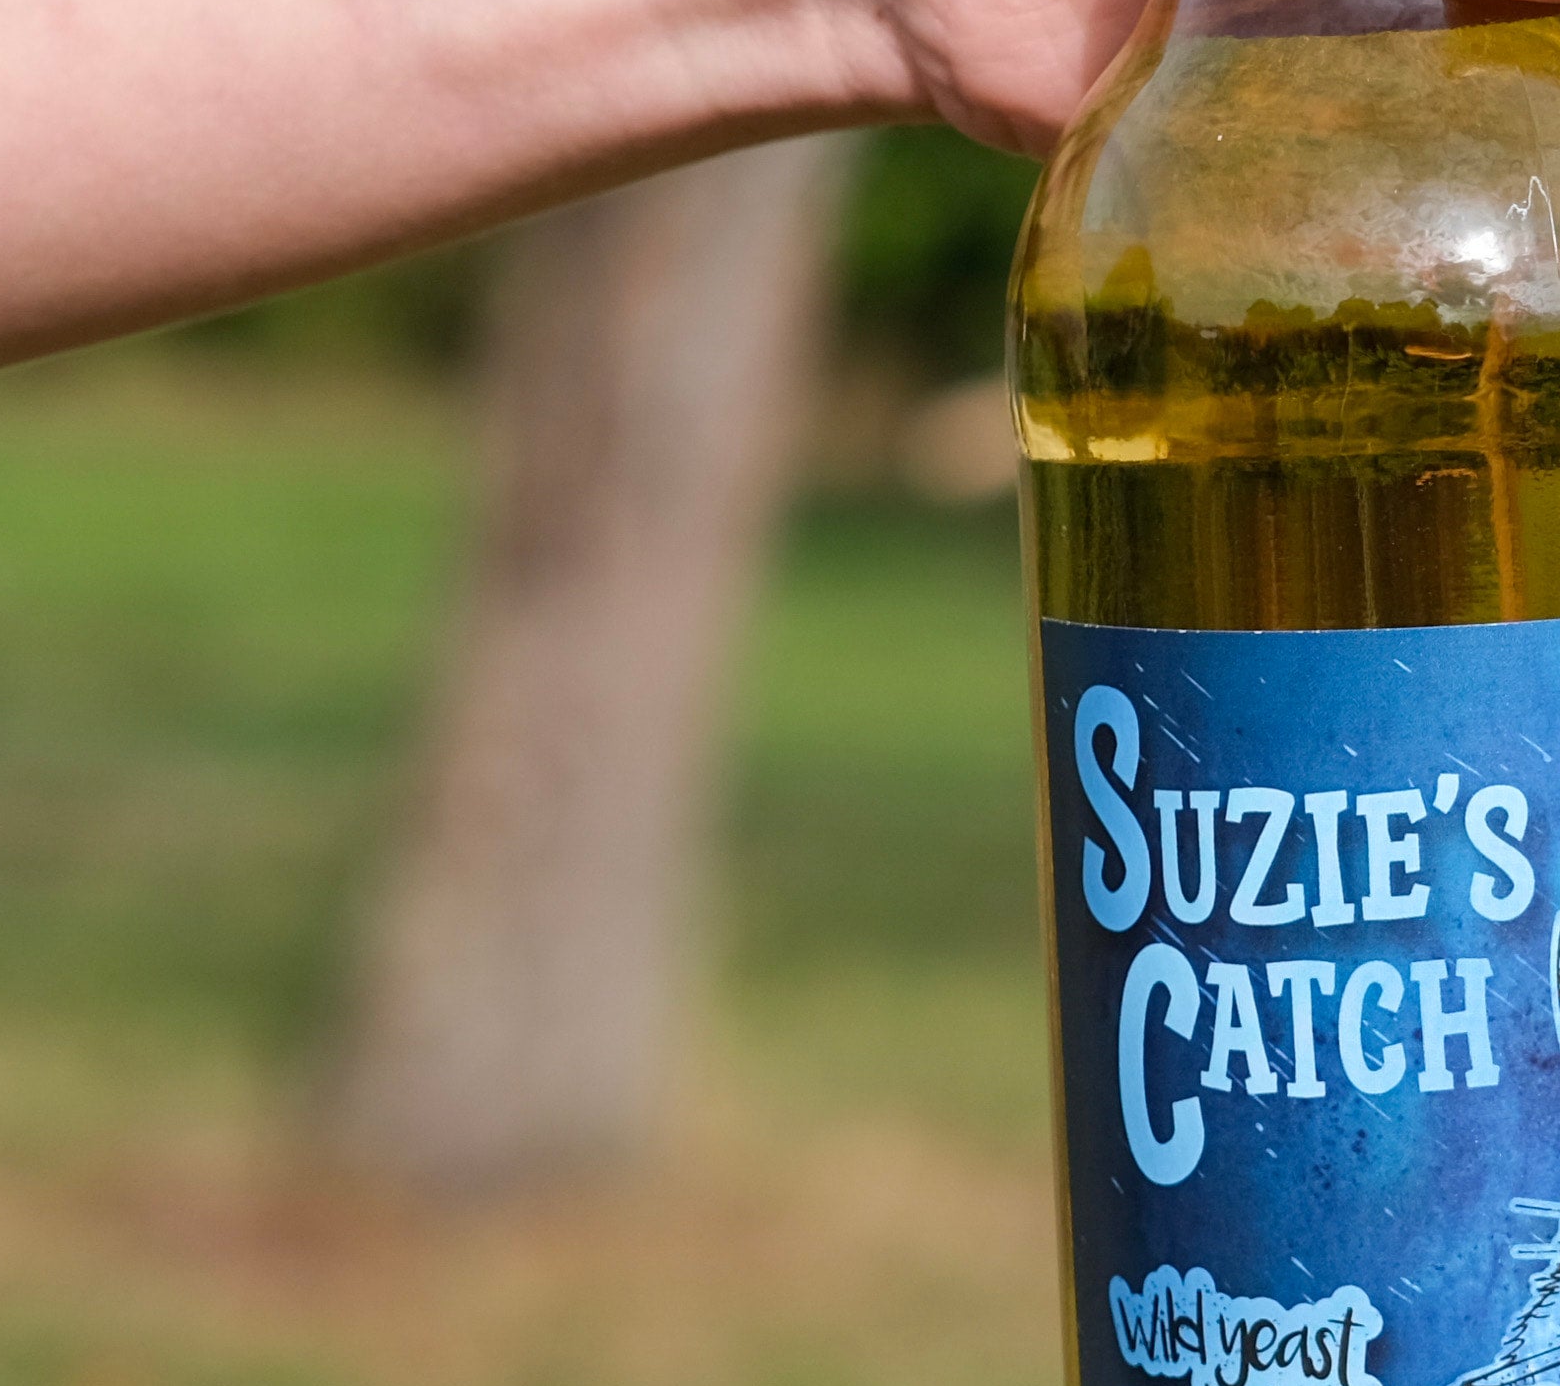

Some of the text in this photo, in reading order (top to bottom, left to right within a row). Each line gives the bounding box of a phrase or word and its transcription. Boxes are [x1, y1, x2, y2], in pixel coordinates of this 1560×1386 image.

[1073, 684, 1536, 932] SUZIE'S
[1118, 942, 1500, 1186] CATCH
[1118, 1286, 1207, 1364] Wild
